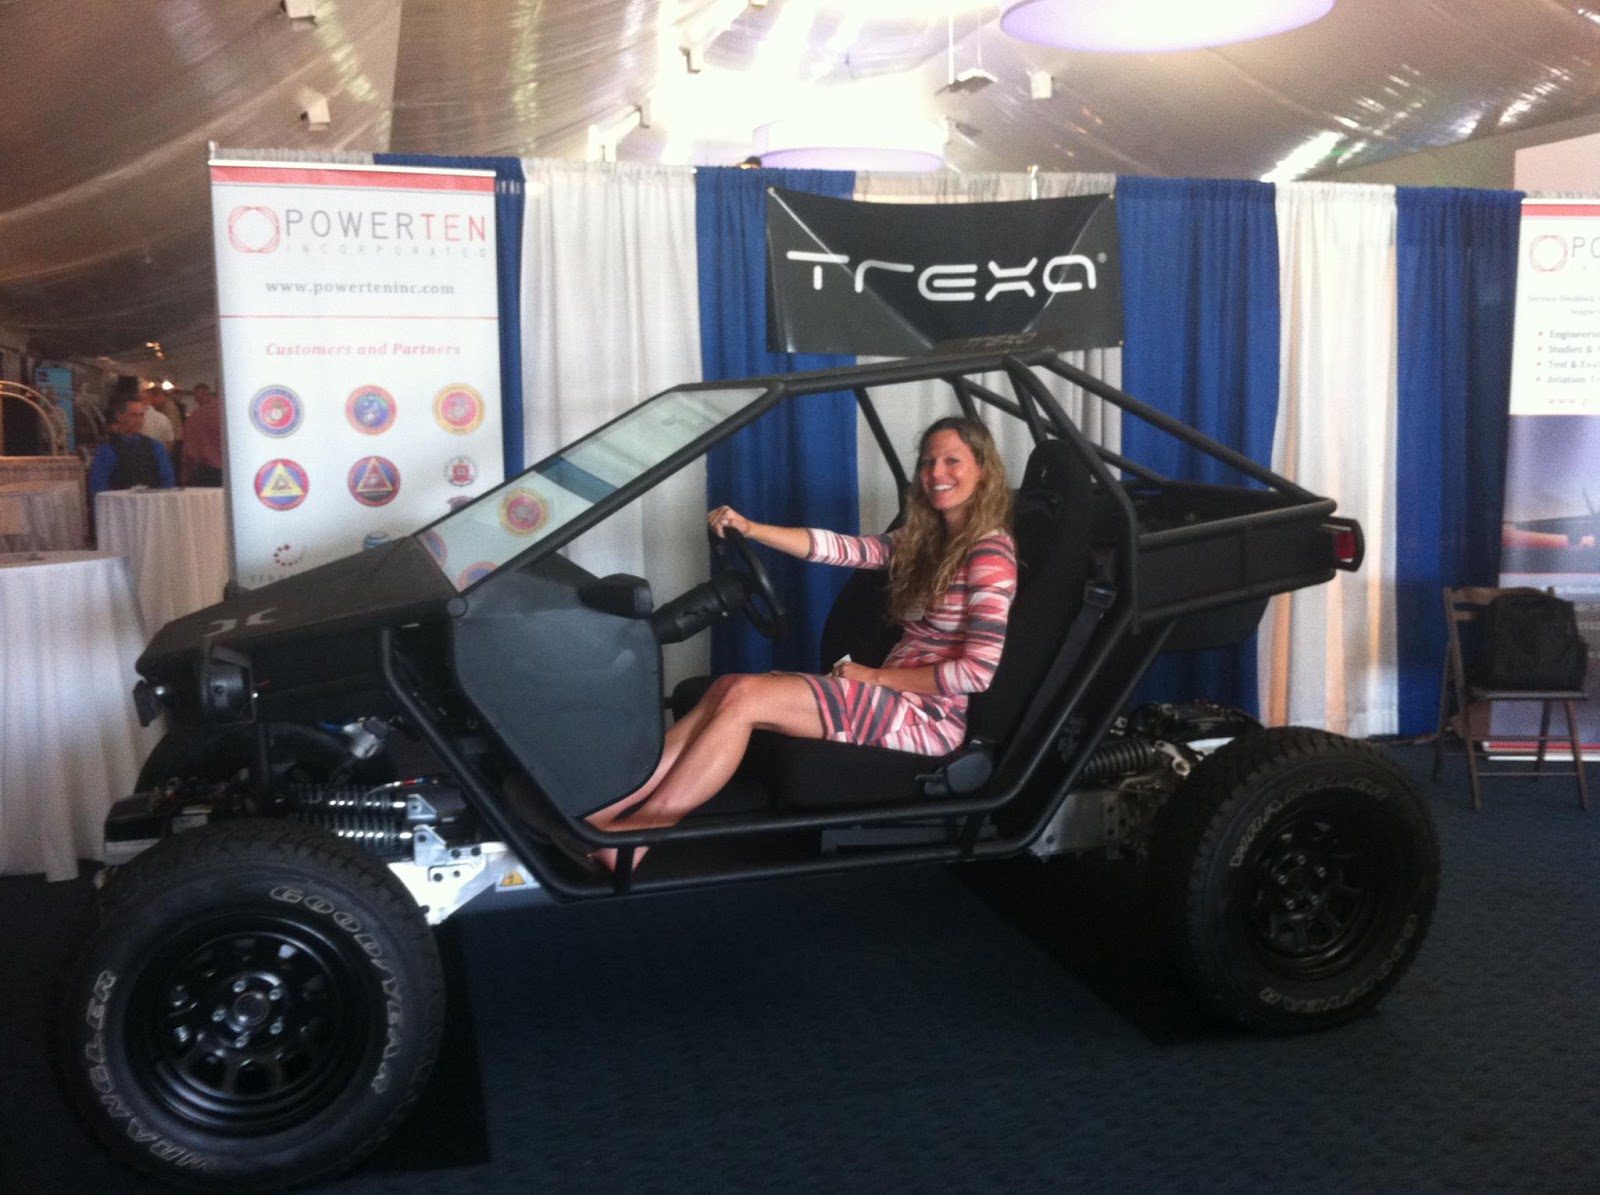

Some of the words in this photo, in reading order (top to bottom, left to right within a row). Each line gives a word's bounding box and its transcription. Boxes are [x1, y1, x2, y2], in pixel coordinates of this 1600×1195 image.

[285, 209, 486, 241] POWERTEN
[265, 280, 455, 296] www.powerteninc.com
[265, 342, 351, 357] Customers
[357, 342, 388, 356] and
[392, 342, 461, 357] Partners
[270, 886, 401, 1094] GOODYEAR
[84, 969, 219, 1174] WRANGLER
